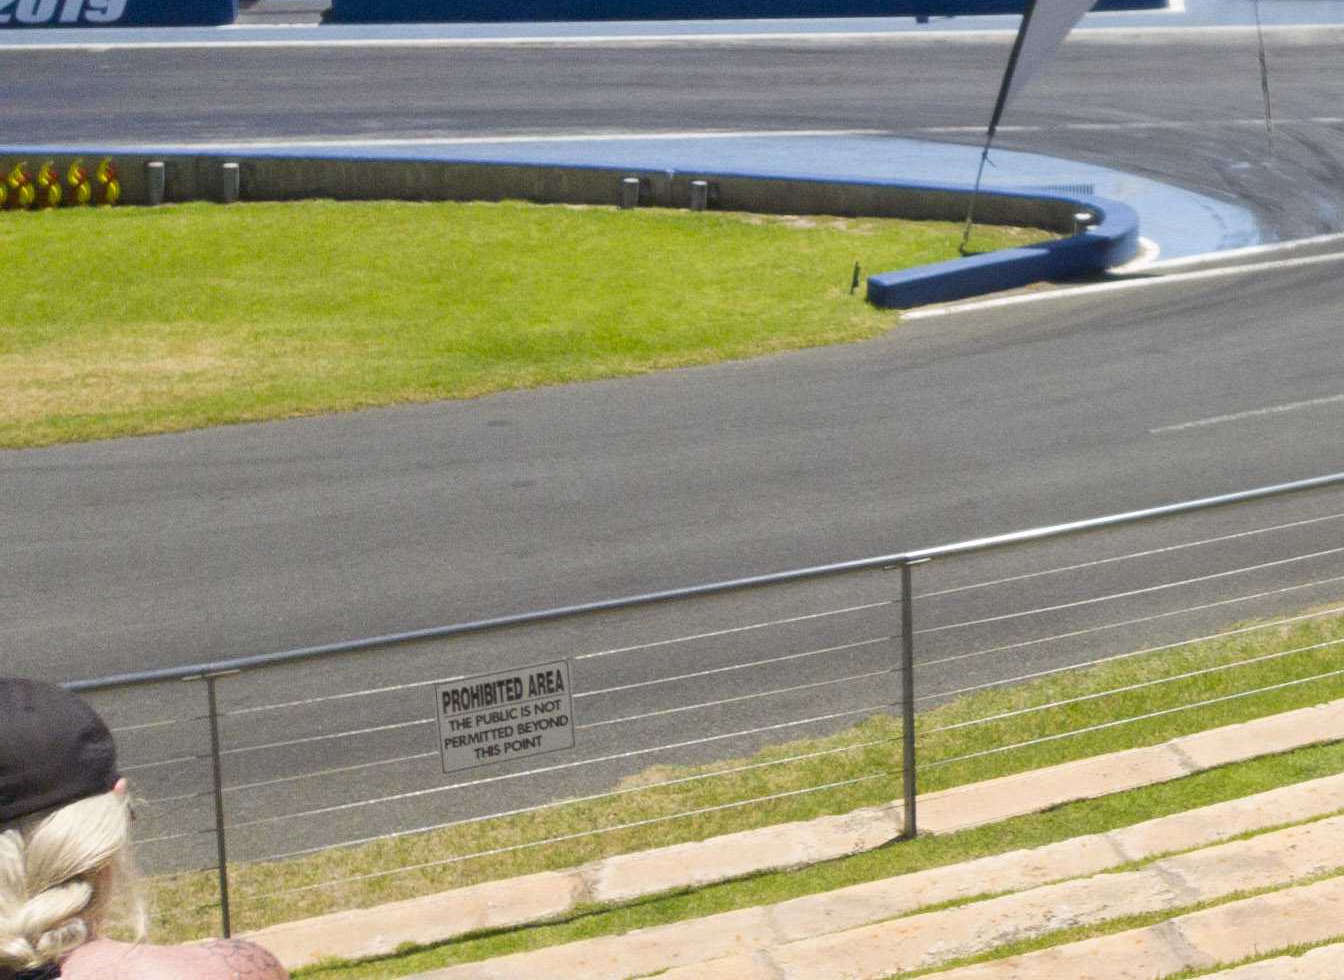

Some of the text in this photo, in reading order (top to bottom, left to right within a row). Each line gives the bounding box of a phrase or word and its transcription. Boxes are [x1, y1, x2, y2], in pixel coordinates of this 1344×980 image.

[442, 669, 565, 714] PROHIBITED AREA
[444, 715, 569, 750] PERMITTED BEYOND
[448, 699, 562, 732] THE PUBLIC IS NOT
[474, 735, 543, 760] THIS POINT
